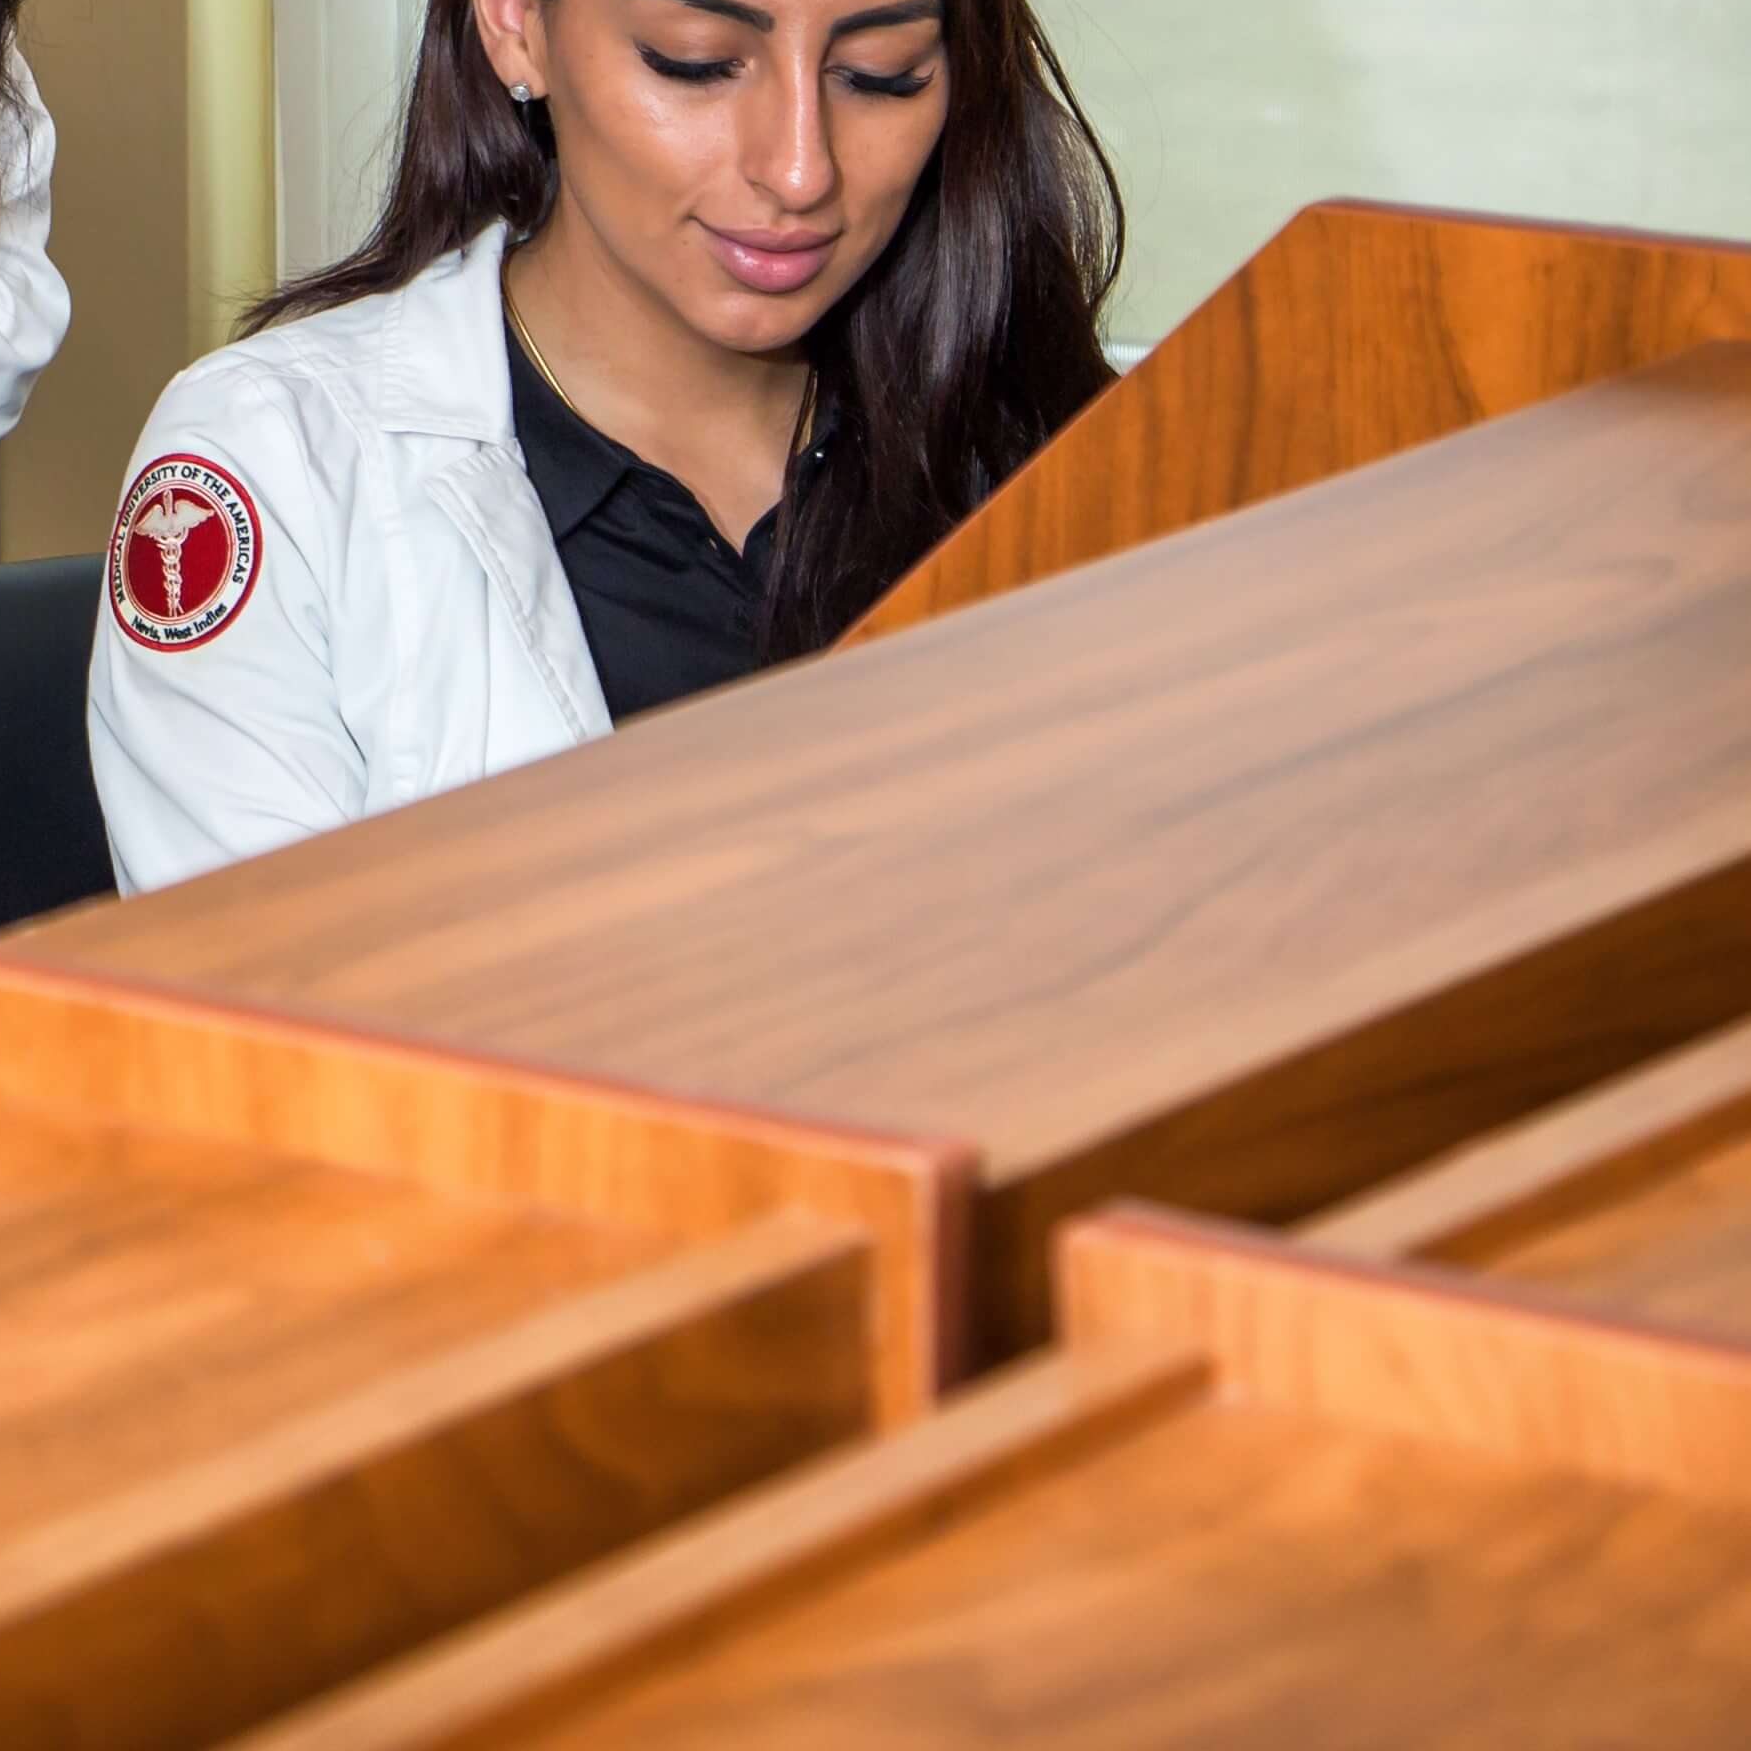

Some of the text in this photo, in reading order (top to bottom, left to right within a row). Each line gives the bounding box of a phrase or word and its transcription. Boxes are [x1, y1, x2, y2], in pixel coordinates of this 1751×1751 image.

[122, 465, 177, 529] UNIVERSITY
[180, 464, 201, 481] OF
[202, 471, 231, 502] THE
[226, 502, 250, 585] AMERICAS
[164, 624, 193, 641] West
